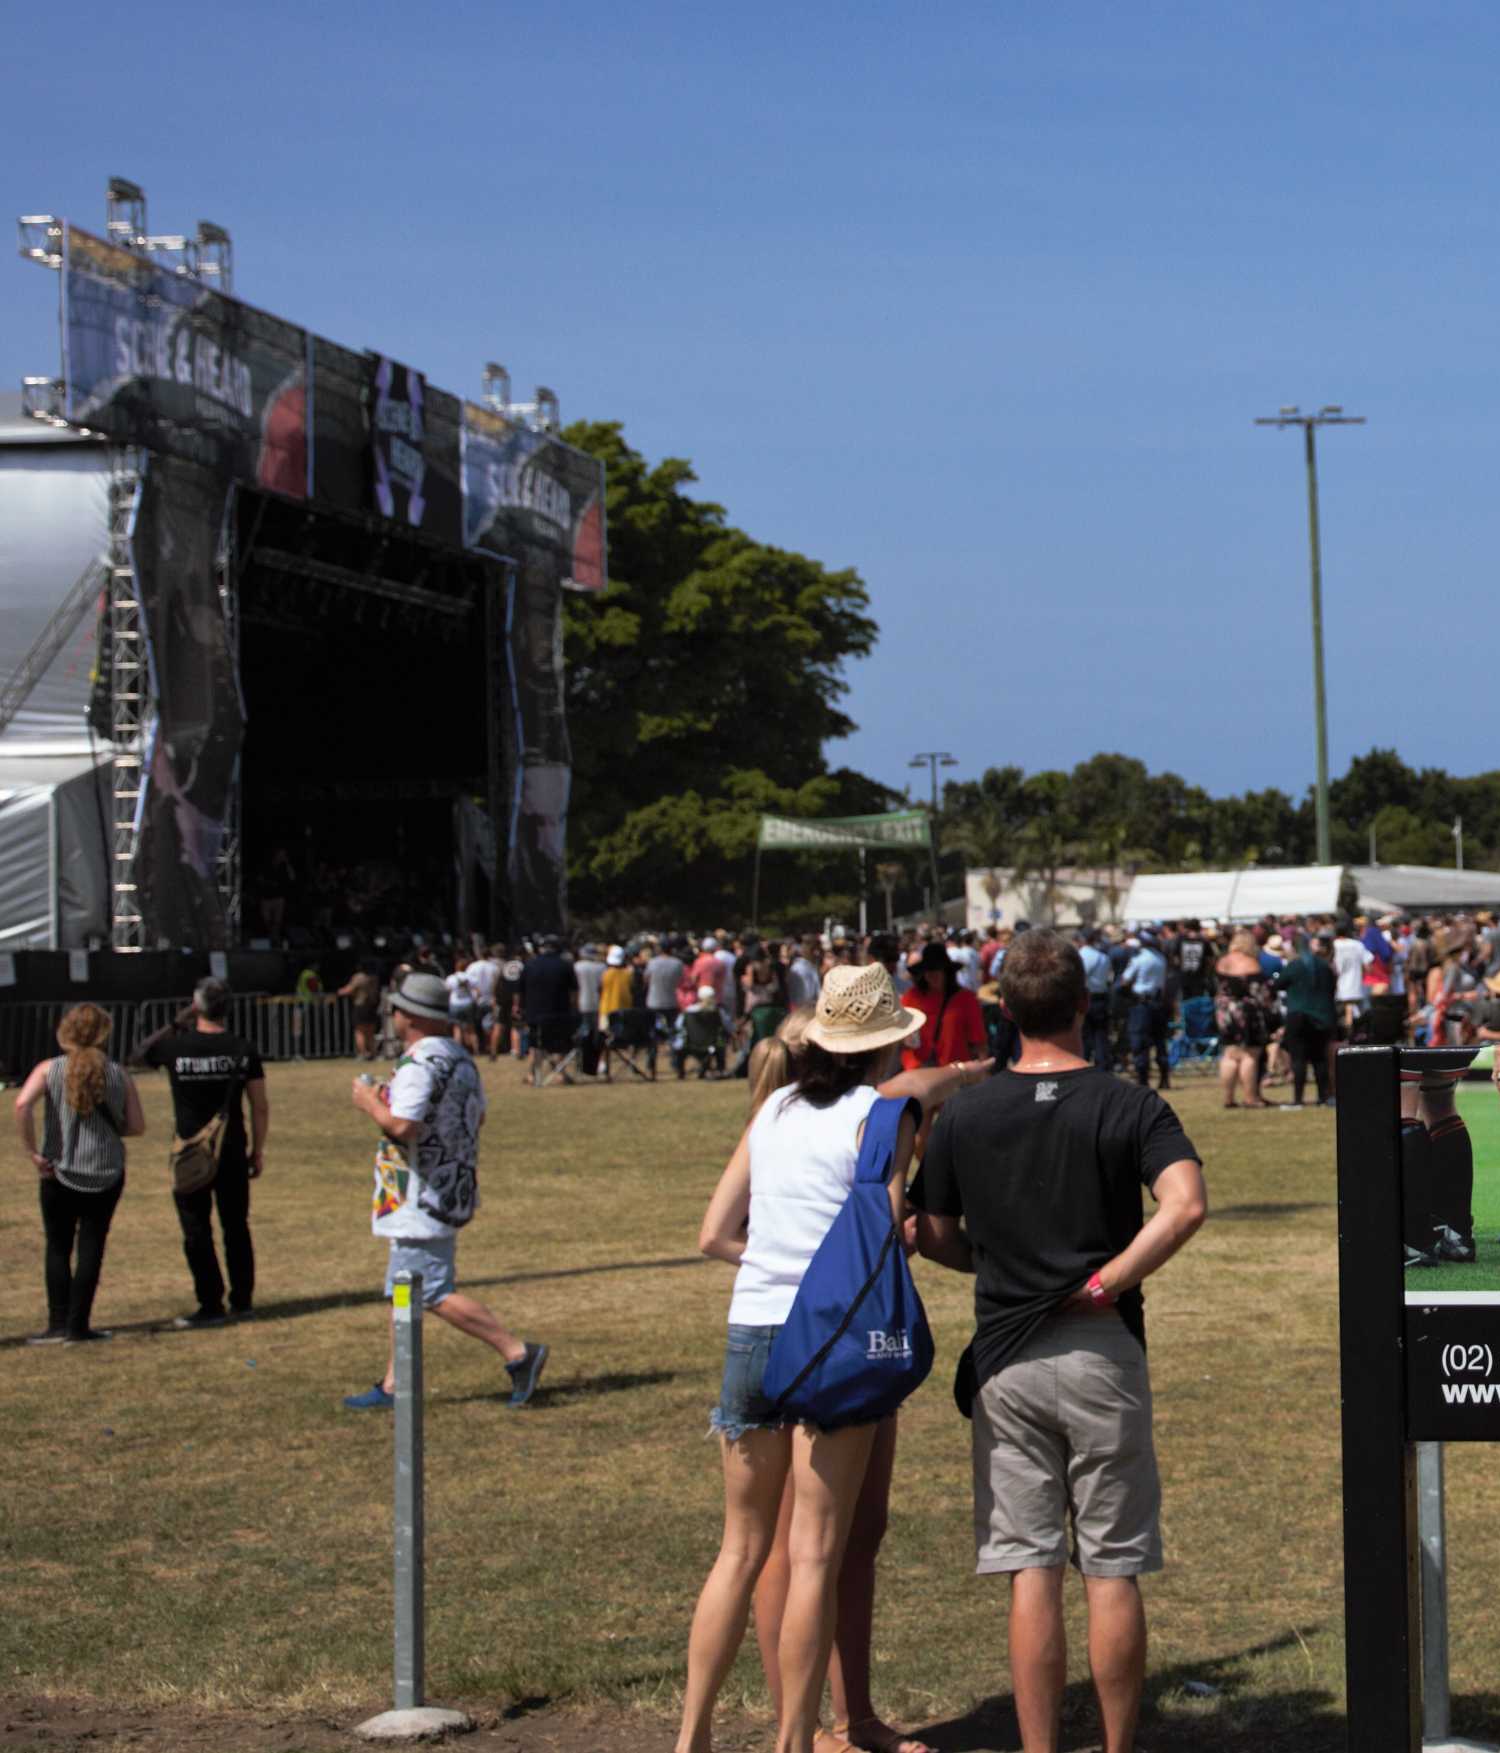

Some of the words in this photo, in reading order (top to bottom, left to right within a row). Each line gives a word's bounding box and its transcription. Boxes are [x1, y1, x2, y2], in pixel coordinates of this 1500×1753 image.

[114, 314, 173, 381] SCE
[881, 817, 923, 843] EXIT
[866, 1329, 910, 1352] Bali
[1441, 1344, 1494, 1377] (02)
